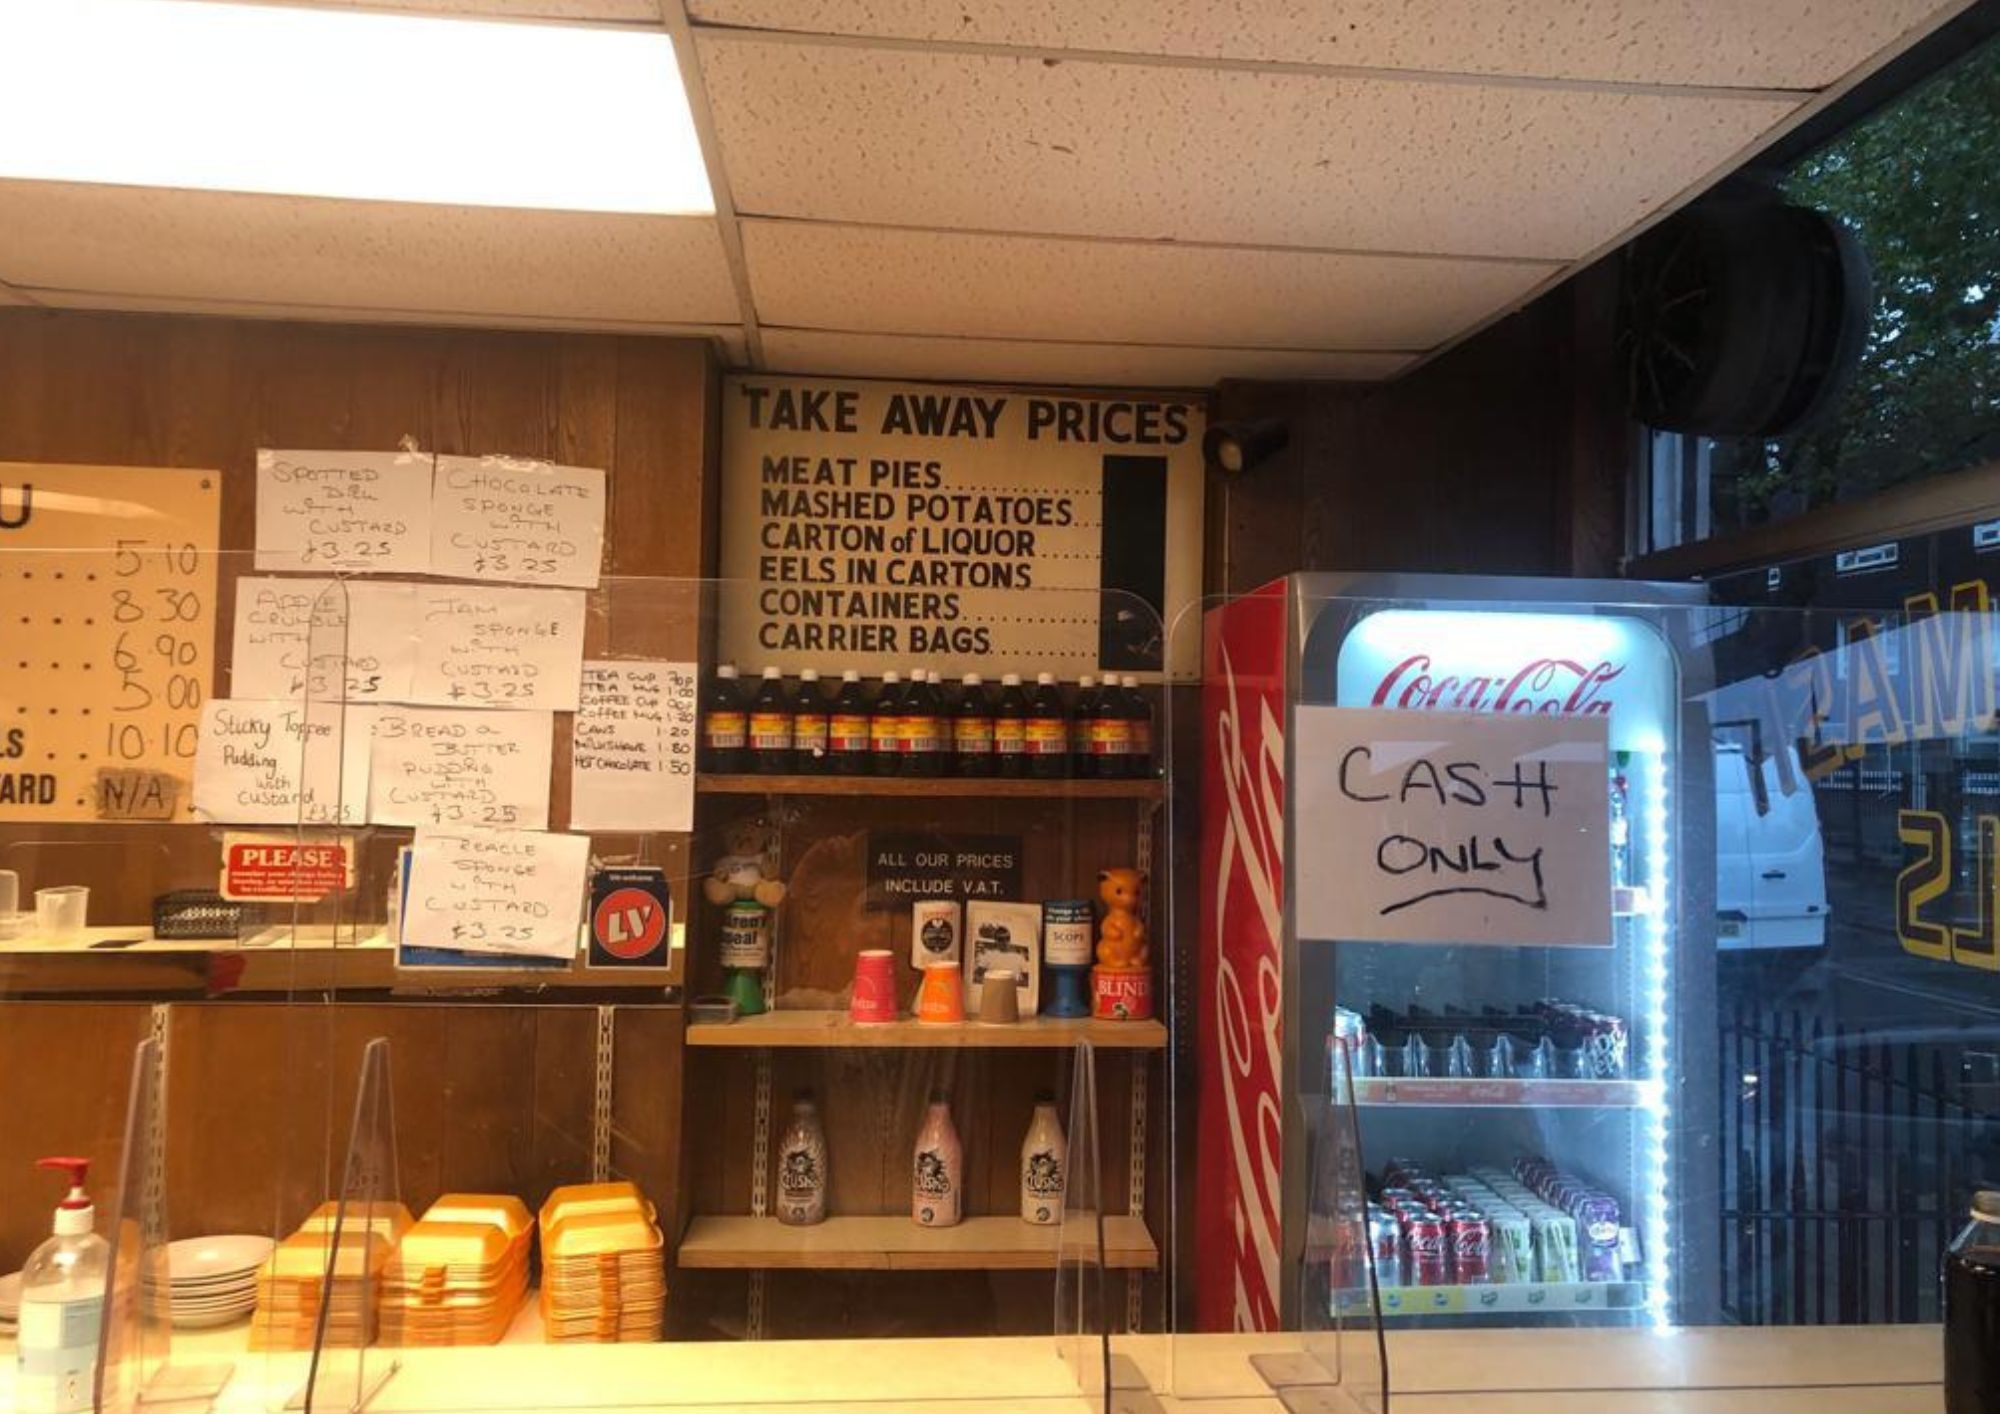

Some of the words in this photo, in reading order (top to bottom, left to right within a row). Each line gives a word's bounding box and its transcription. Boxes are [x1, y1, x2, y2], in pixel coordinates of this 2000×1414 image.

[742, 385, 859, 433] TAKE
[881, 394, 1008, 439] AWAY
[1027, 400, 1190, 445] PRICES
[271, 461, 379, 483] SPOTTED
[447, 468, 591, 499] CHOCOLATE
[762, 456, 857, 486] MEAT
[870, 461, 942, 489] PIES
[463, 498, 554, 516] SPONGE
[762, 491, 896, 521] MASHED
[907, 495, 1073, 526] POTATOES
[308, 519, 407, 535] CUSTARD
[451, 532, 577, 556] CUSTARD
[762, 523, 884, 552] CARTON
[891, 528, 916, 553] of
[922, 530, 1036, 557] LIQUOR
[760, 556, 835, 583] EELS
[848, 559, 876, 584] IN
[887, 560, 1032, 589] CARTONS
[760, 589, 960, 620] CONTAINERS
[473, 622, 559, 636] SPONGE
[760, 623, 898, 652] CARRIER
[909, 627, 990, 655] BAGS
[581, 670, 619, 681] TEA
[627, 672, 656, 683] CUP
[581, 682, 618, 692] TEA
[633, 684, 660, 693] MUG
[580, 694, 630, 706] COFFEE
[636, 696, 658, 707] CUP
[580, 707, 626, 719] COFFEE
[213, 708, 271, 750] Sticky
[379, 716, 466, 738] BREAD
[577, 722, 615, 735] CANS
[0, 728, 24, 758] S
[223, 745, 277, 780] Pudding
[0, 773, 56, 804] ARD
[103, 776, 164, 814] N/A
[256, 775, 291, 790] with
[1338, 746, 1559, 817] CASH
[241, 848, 334, 867] PLEASE
[878, 853, 907, 867] ALL
[916, 853, 949, 867] OUR
[956, 855, 1014, 869] PRICES
[1377, 835, 1546, 905] ONLY
[885, 879, 954, 893] INCLUDE
[425, 897, 549, 918] CUSTARD
[608, 905, 652, 944] LV
